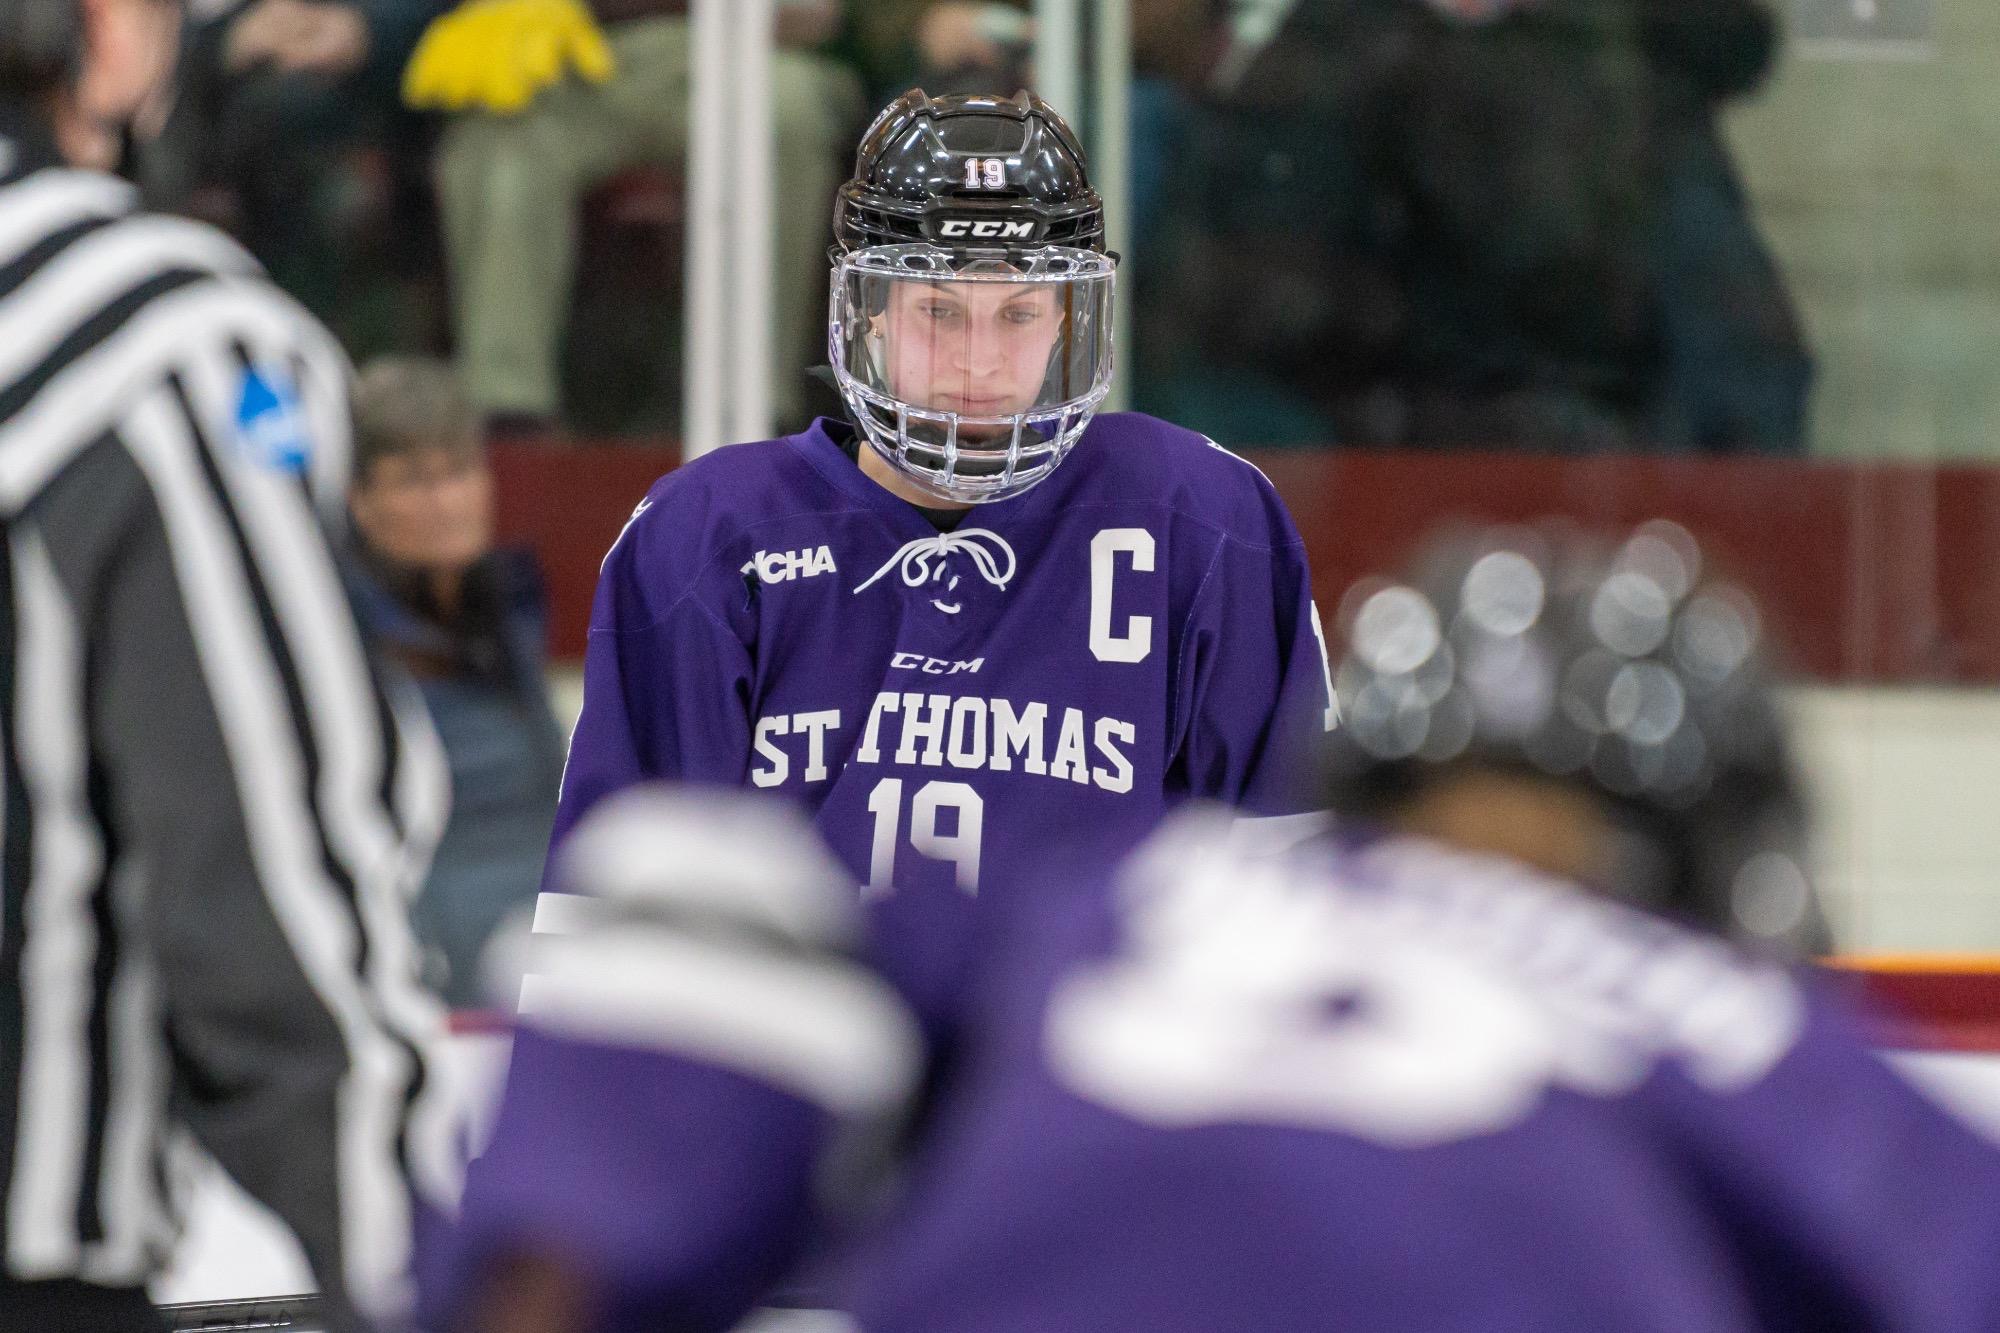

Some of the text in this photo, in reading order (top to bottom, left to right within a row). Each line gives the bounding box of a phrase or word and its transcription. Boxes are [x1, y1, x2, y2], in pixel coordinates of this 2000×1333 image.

[965, 158, 1006, 189] 19
[940, 220, 1035, 237] CCM
[1089, 528, 1155, 663] C
[890, 652, 985, 675] CCM
[857, 691, 1135, 794] THOMAS
[859, 777, 984, 900] 19
